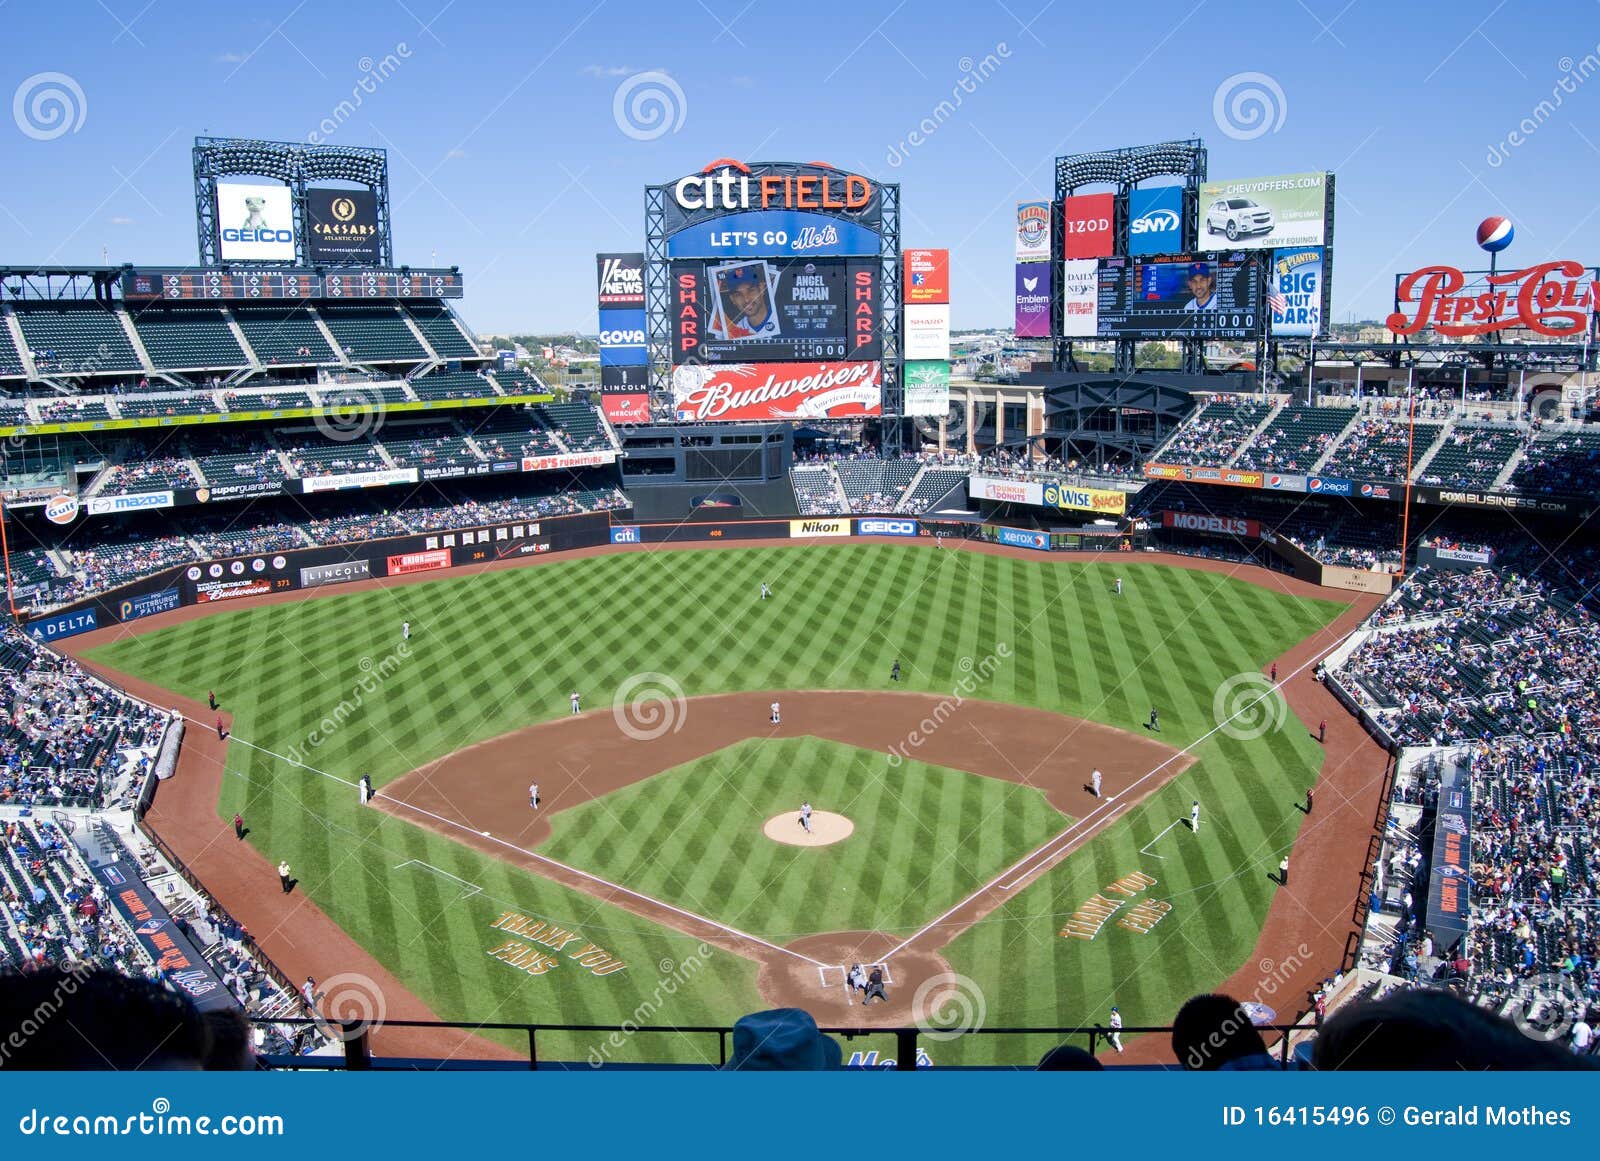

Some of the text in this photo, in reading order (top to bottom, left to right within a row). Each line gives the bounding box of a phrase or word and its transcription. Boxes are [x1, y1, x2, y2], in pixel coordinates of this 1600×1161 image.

[675, 166, 871, 210] citi FIELD
[1226, 176, 1321, 194] CHEVYOFFERS.COM
[313, 223, 376, 235] CAESARS
[1068, 218, 1109, 233] IZOD
[1131, 215, 1174, 235] SNY
[222, 228, 293, 243] GEICO
[710, 225, 839, 250] LET'S GO Mets
[1262, 235, 1318, 247] CHEVY EQUINOX
[1288, 252, 1320, 267] PLANTERS
[614, 268, 642, 281] FOX
[795, 275, 825, 287] ANGEL
[1067, 272, 1095, 281] DAILY
[604, 281, 643, 294] NEWS
[1067, 284, 1095, 295] NEWS
[1279, 272, 1316, 294] BIG
[792, 286, 829, 301] PAGAN
[1016, 295, 1049, 304] Emblem
[1285, 294, 1311, 307] NUT
[679, 273, 698, 351] SHARP
[855, 271, 873, 348] SHARP
[1020, 304, 1046, 314] Health
[1273, 308, 1319, 324] BARS
[1219, 315, 1253, 327] 0 0 0
[600, 330, 645, 344] GOYA
[816, 345, 844, 355] 0 0 0
[687, 363, 869, 420] Budweiser
[812, 390, 877, 410] American Lager
[609, 409, 642, 417] MERCURY
[424, 467, 441, 475] Watch
[468, 466, 476, 474] At
[523, 457, 558, 471] BOB'S
[559, 455, 603, 467] FURNITURE
[311, 472, 410, 488] Alliance Building Services
[1148, 466, 1180, 478] SUBWAY
[1225, 473, 1260, 484] SUBWAY
[211, 480, 283, 496] superguarantee
[1323, 482, 1349, 493] pepsi
[114, 494, 168, 509] mazda
[996, 493, 1026, 501] DONUTS
[1061, 489, 1125, 509] WISE SNACKS
[49, 502, 75, 518] Gulf
[801, 521, 839, 533] Nikon
[860, 521, 914, 534] GEICO
[1173, 513, 1248, 536] MODELL'S
[614, 530, 635, 542] citi
[1003, 531, 1034, 544] xerox
[520, 543, 550, 553] verizon
[309, 565, 369, 580] LINCOLN
[276, 579, 290, 588] 371
[206, 584, 270, 601] Budweiser
[134, 594, 178, 611] PITTSBURGH
[140, 602, 174, 616] PAINTS
[47, 615, 95, 635] DELTA
[1059, 870, 1158, 940] THANK YOU
[490, 911, 628, 976] THANK YOU
[486, 939, 560, 975] FANS
[170, 970, 218, 996] Mets
